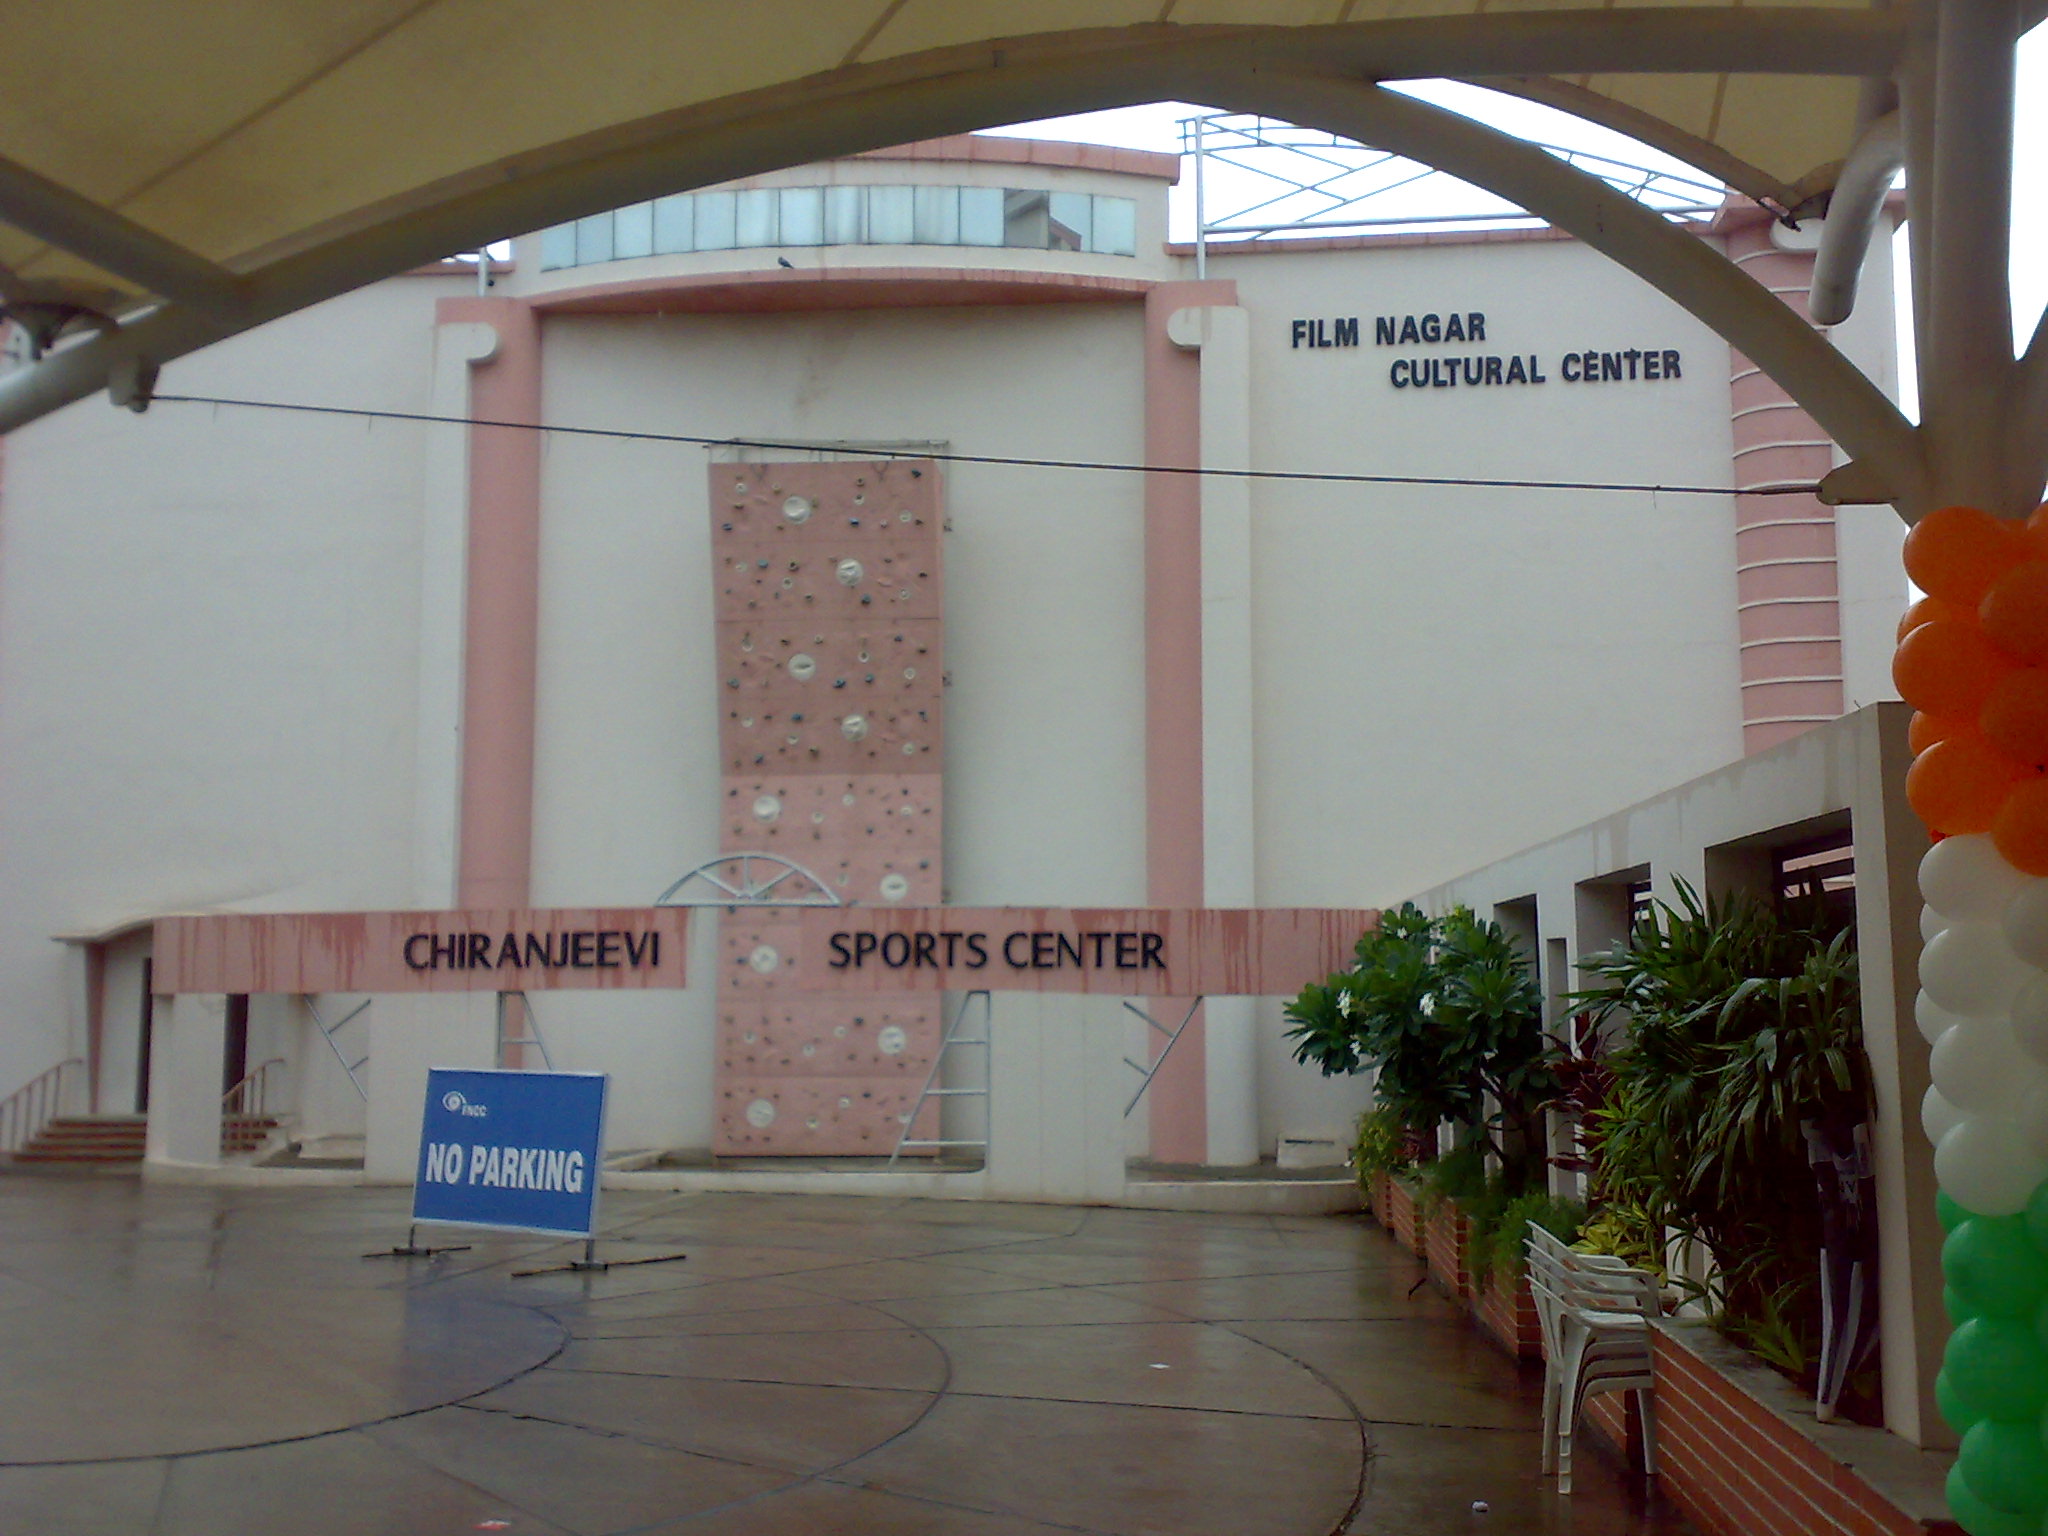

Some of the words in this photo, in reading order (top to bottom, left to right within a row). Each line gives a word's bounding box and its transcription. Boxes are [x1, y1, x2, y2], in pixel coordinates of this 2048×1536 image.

[1292, 318, 1358, 348] FILM
[1376, 313, 1486, 345] NAGAR
[1390, 355, 1546, 388] CULTURAL
[1561, 348, 1682, 382] CENTER
[404, 931, 660, 969] CHIRANJEEVI
[829, 932, 988, 969] SPORTS
[1003, 932, 1167, 969] CENTER
[425, 1142, 463, 1184] NO
[468, 1145, 584, 1193] PARKING
